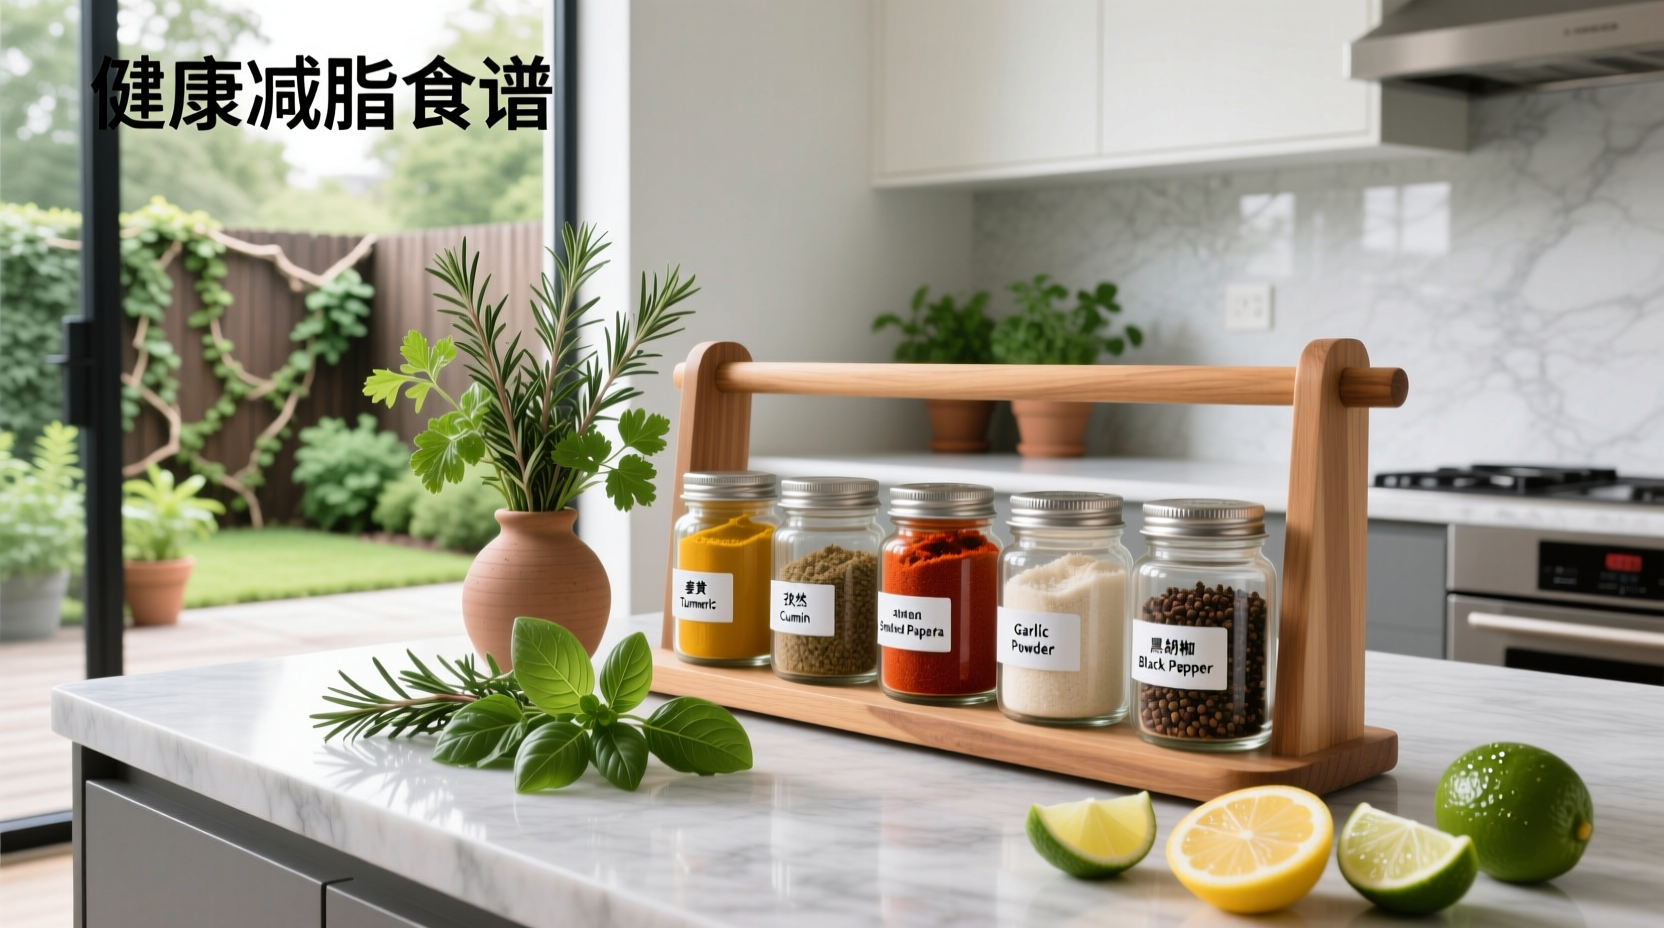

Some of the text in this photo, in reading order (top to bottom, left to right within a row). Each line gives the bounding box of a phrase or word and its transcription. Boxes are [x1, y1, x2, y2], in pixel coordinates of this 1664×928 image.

[780, 610, 810, 624] Cumin
[1014, 623, 1049, 638] Garlic
[1011, 639, 1055, 655] Powder
[1139, 655, 1213, 678] Black Pepper
